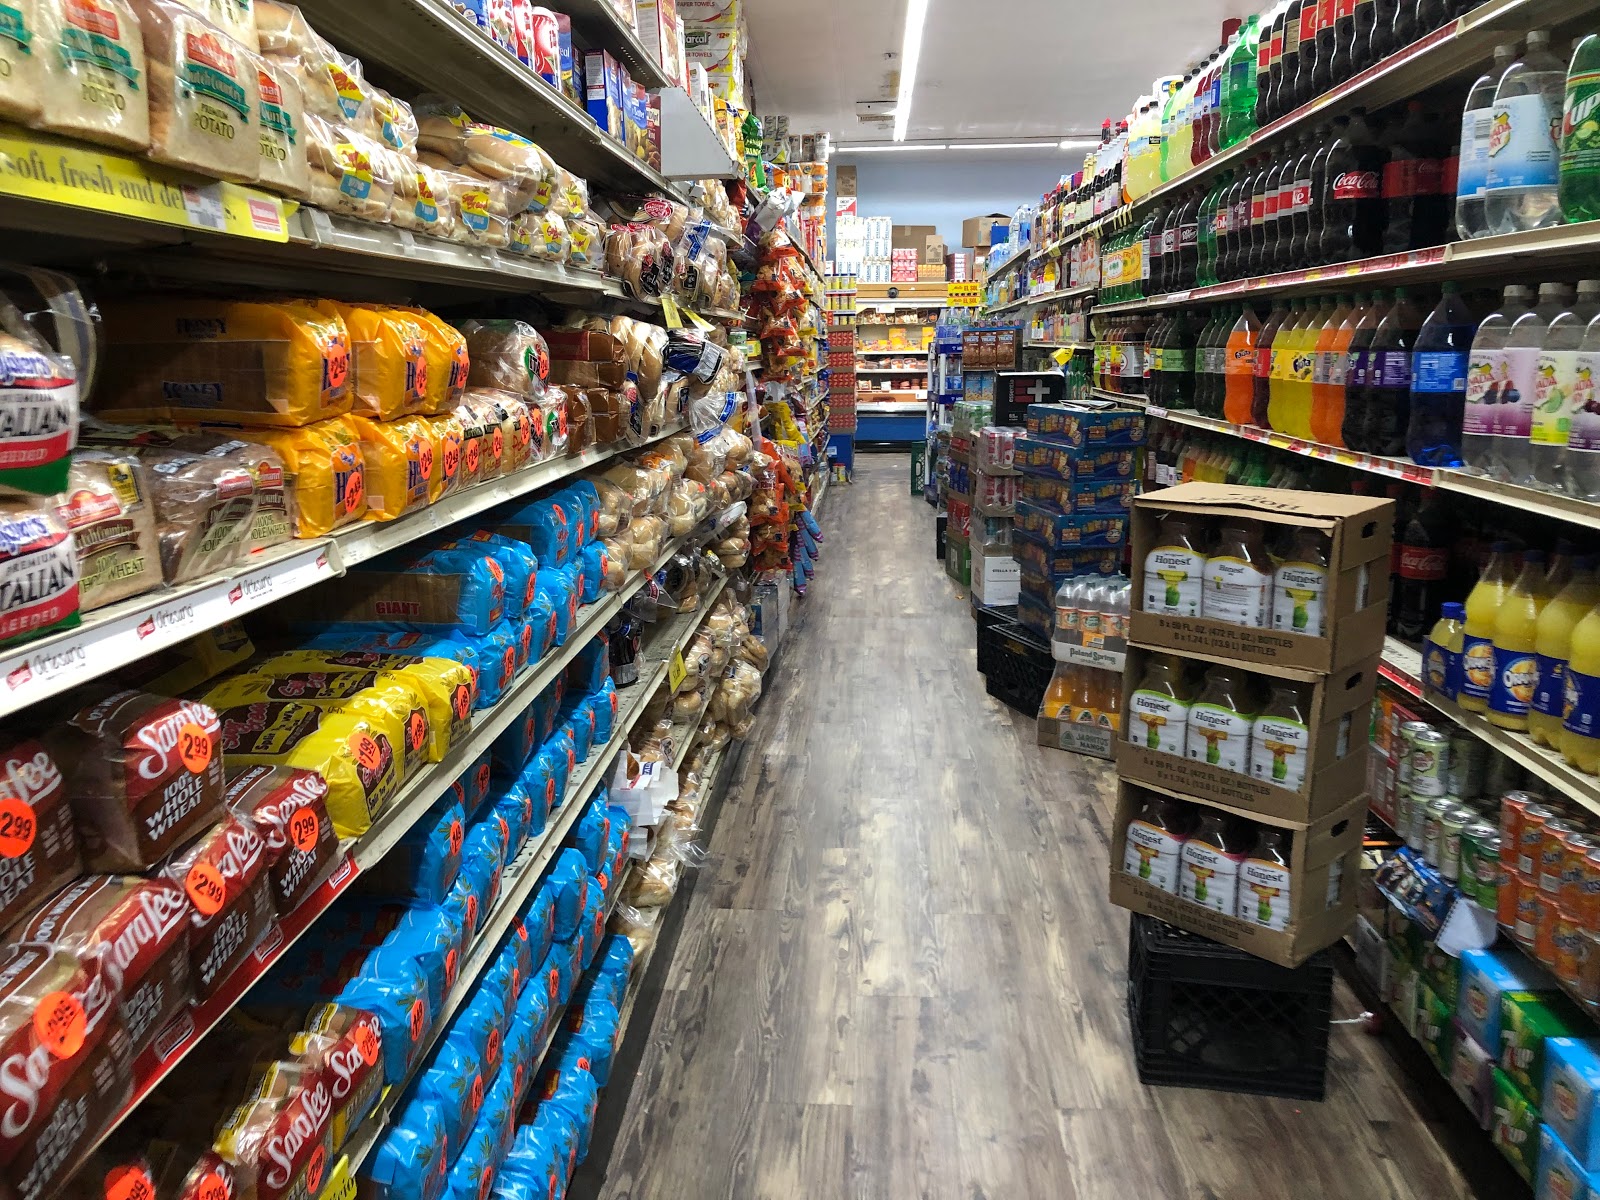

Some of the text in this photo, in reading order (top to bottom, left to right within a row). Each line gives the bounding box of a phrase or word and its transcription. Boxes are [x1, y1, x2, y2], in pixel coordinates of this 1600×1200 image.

[194, 112, 235, 140] POTATO
[258, 141, 287, 162] OTATO
[6, 150, 155, 204] soft, fresh and
[1333, 172, 1379, 190] Coca-Cola
[0, 449, 48, 462] EEDED
[6, 551, 57, 573] PREMIUM
[1154, 555, 1191, 566] Honest
[1219, 564, 1244, 574] Honest
[0, 553, 74, 611] TALIAN
[1281, 572, 1322, 585] Honest
[375, 601, 421, 616] GIANT
[1242, 643, 1276, 656] BOTTLES
[1258, 634, 1293, 648] BOTTLES
[1070, 648, 1093, 658] Poland
[1093, 651, 1116, 665] Spring
[1136, 697, 1171, 713] Honest
[1195, 711, 1231, 727] Honest
[1261, 724, 1300, 740] Honest
[146, 775, 203, 827] WHOLE
[149, 790, 202, 841] WHEAT
[1131, 827, 1163, 845] Honest
[1186, 847, 1218, 865] Honest
[283, 849, 318, 898] WHEAT
[1246, 866, 1283, 883] Honest
[266, 1081, 331, 1189] Sara Lee
